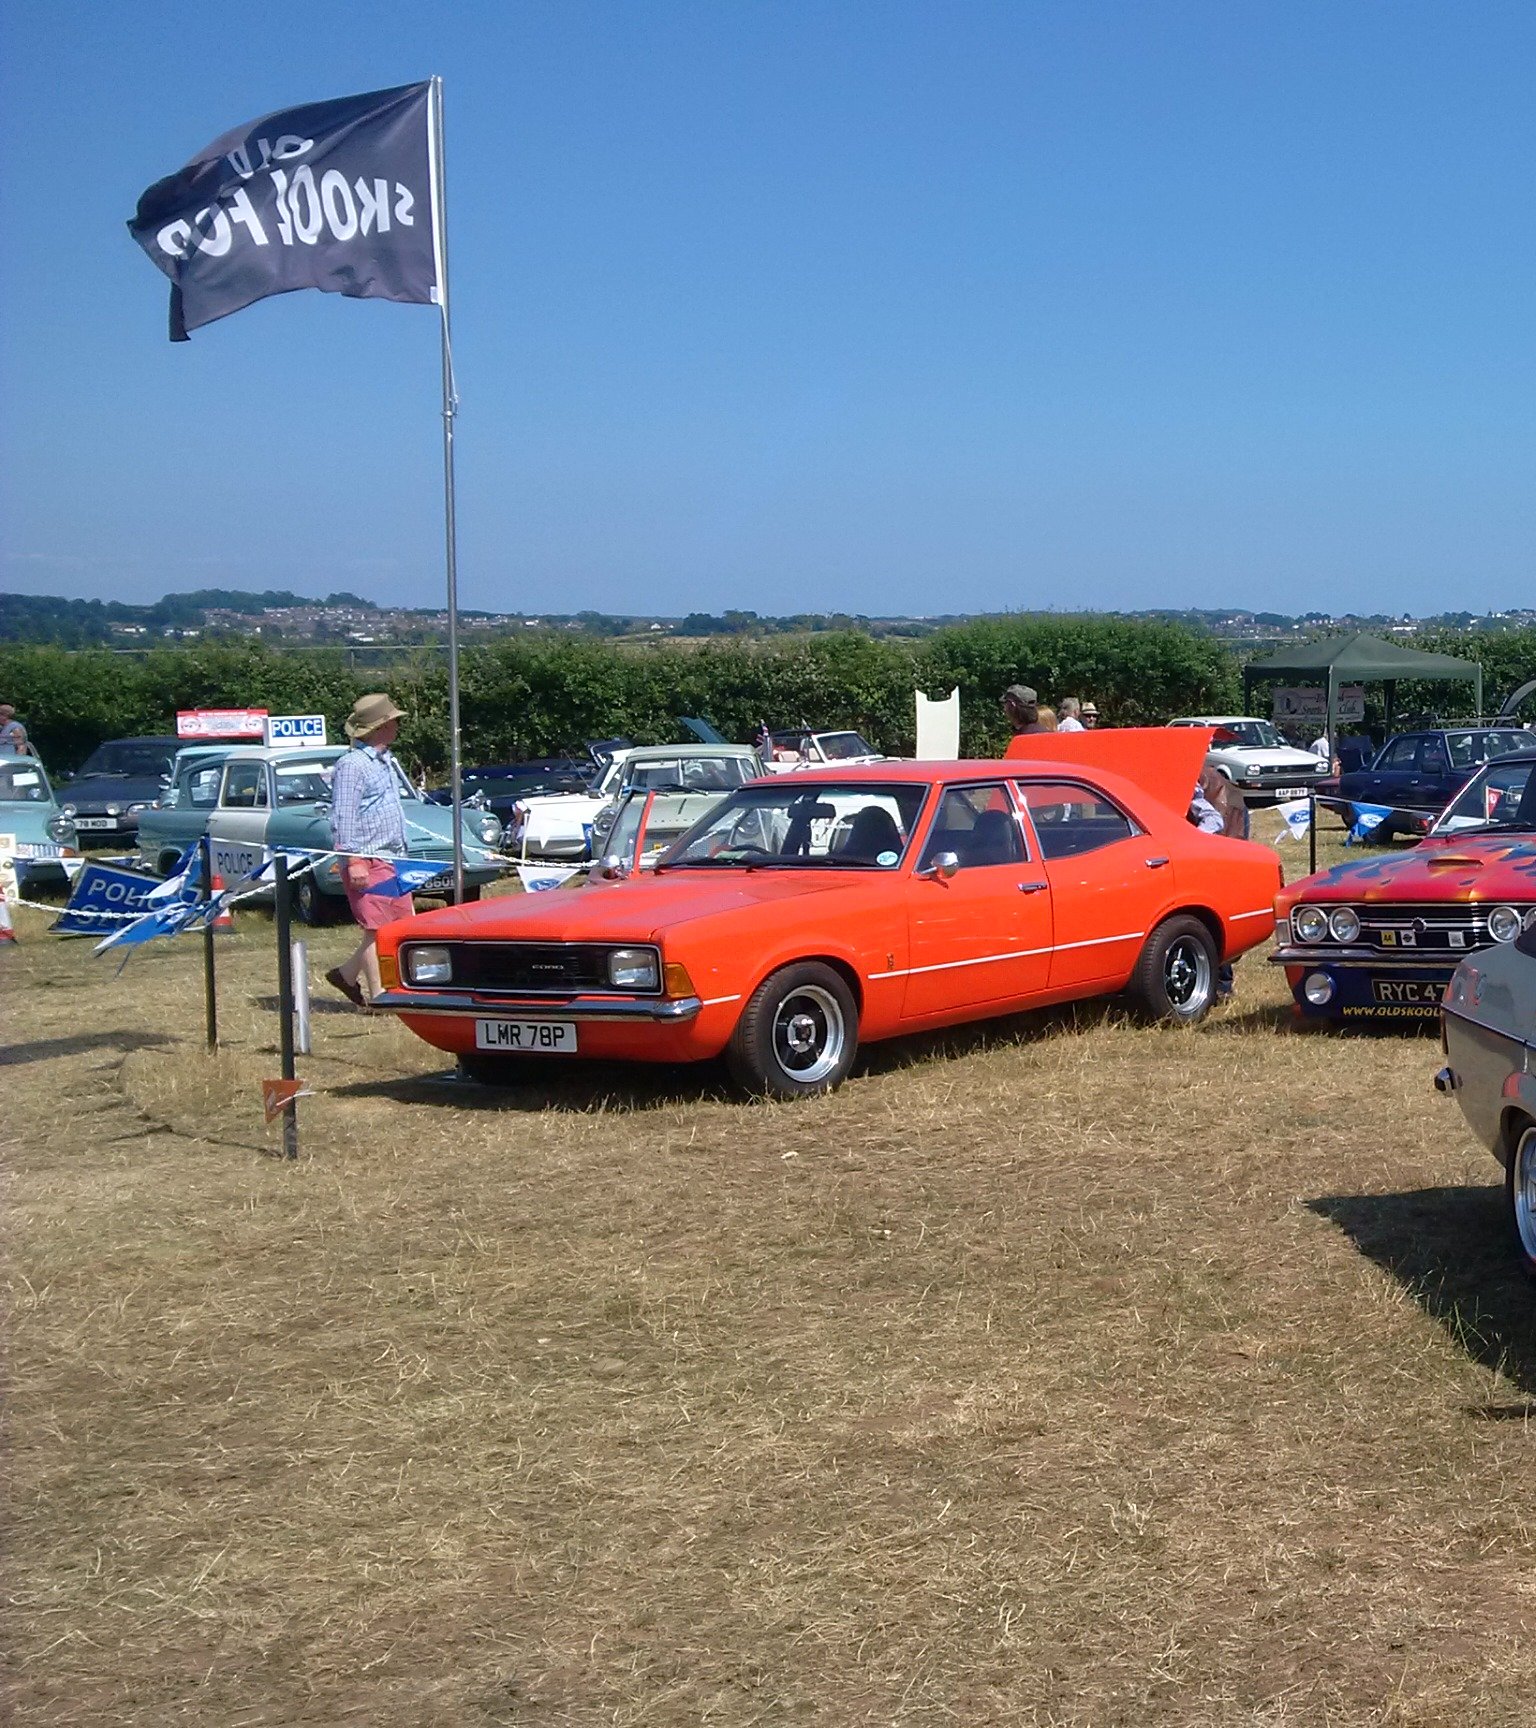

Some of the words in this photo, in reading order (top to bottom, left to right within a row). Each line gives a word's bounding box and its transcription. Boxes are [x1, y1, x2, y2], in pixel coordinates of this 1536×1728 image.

[272, 719, 322, 736] POLICE
[217, 853, 252, 874] POLICE
[87, 879, 166, 911] POLIC
[1379, 983, 1419, 1001] RYC
[485, 1023, 521, 1045] LMR
[526, 1025, 565, 1047] 78P
